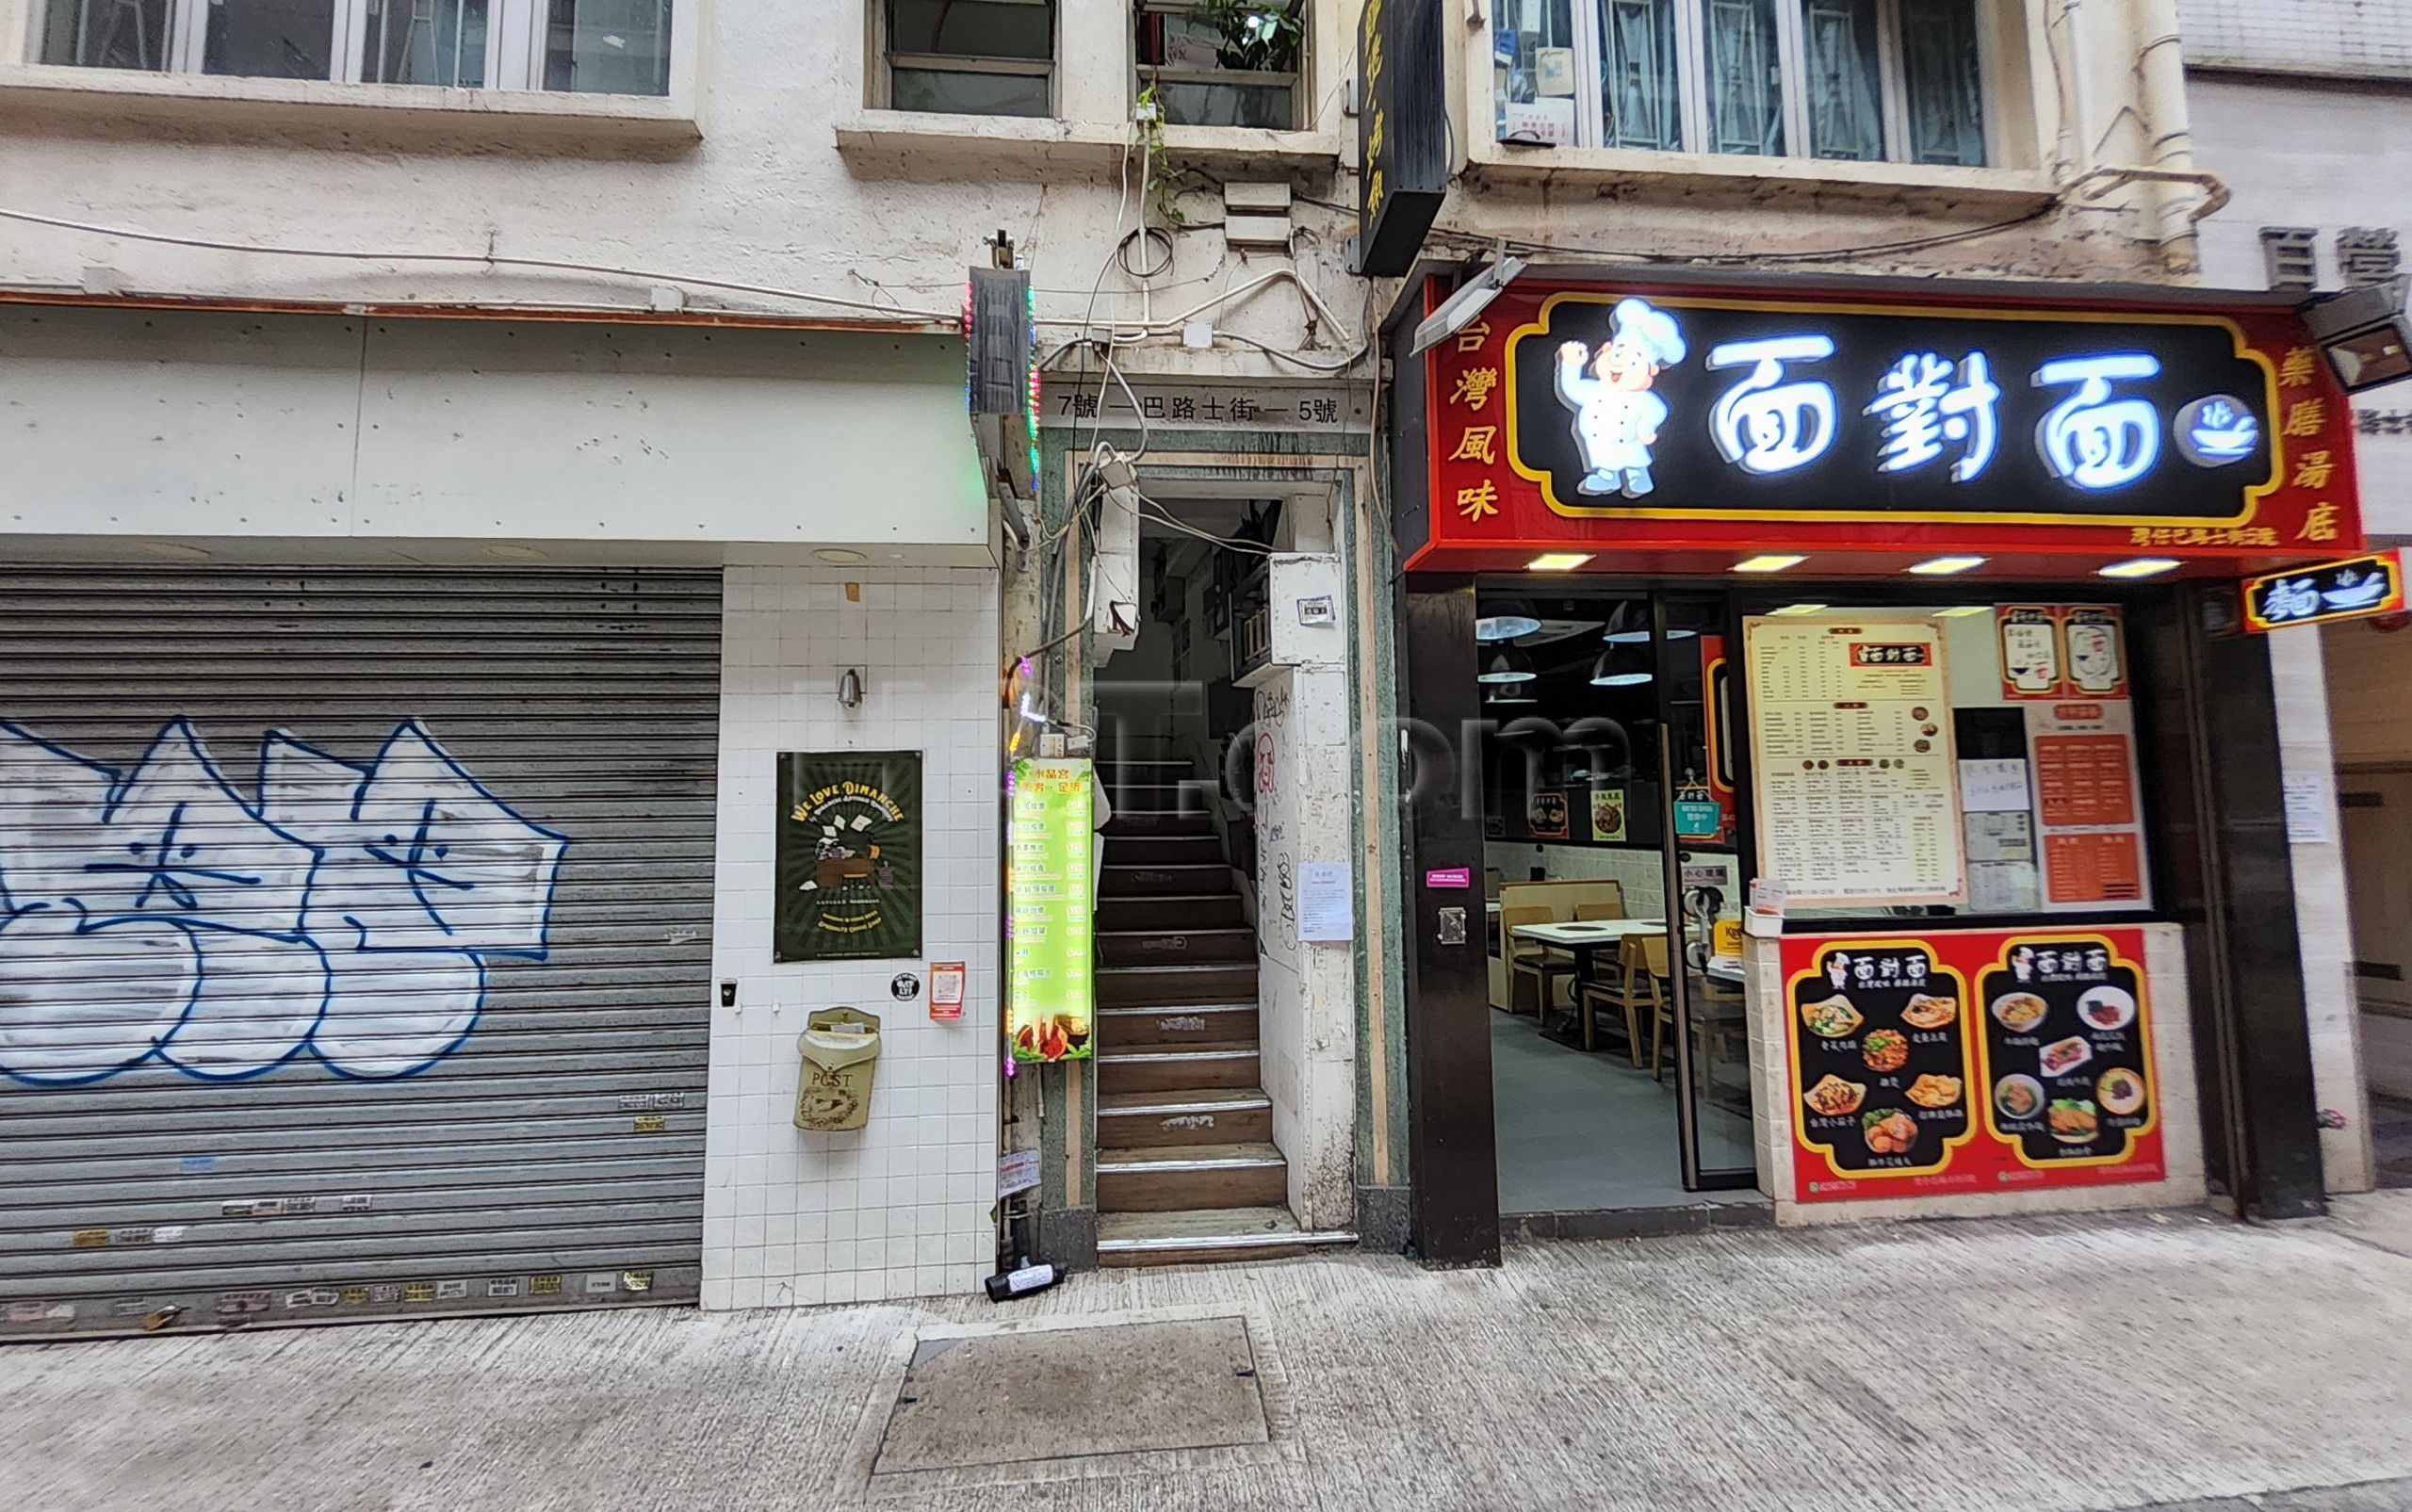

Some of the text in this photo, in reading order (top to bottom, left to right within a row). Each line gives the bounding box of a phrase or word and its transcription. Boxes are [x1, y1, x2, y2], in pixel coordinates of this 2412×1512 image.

[1143, 396, 1256, 423] 巴路士街
[1449, 314, 1500, 523] 台灣風味
[1709, 333, 2162, 490] 面對面
[1852, 954, 1927, 981] 面對面
[811, 1071, 854, 1088] POST
